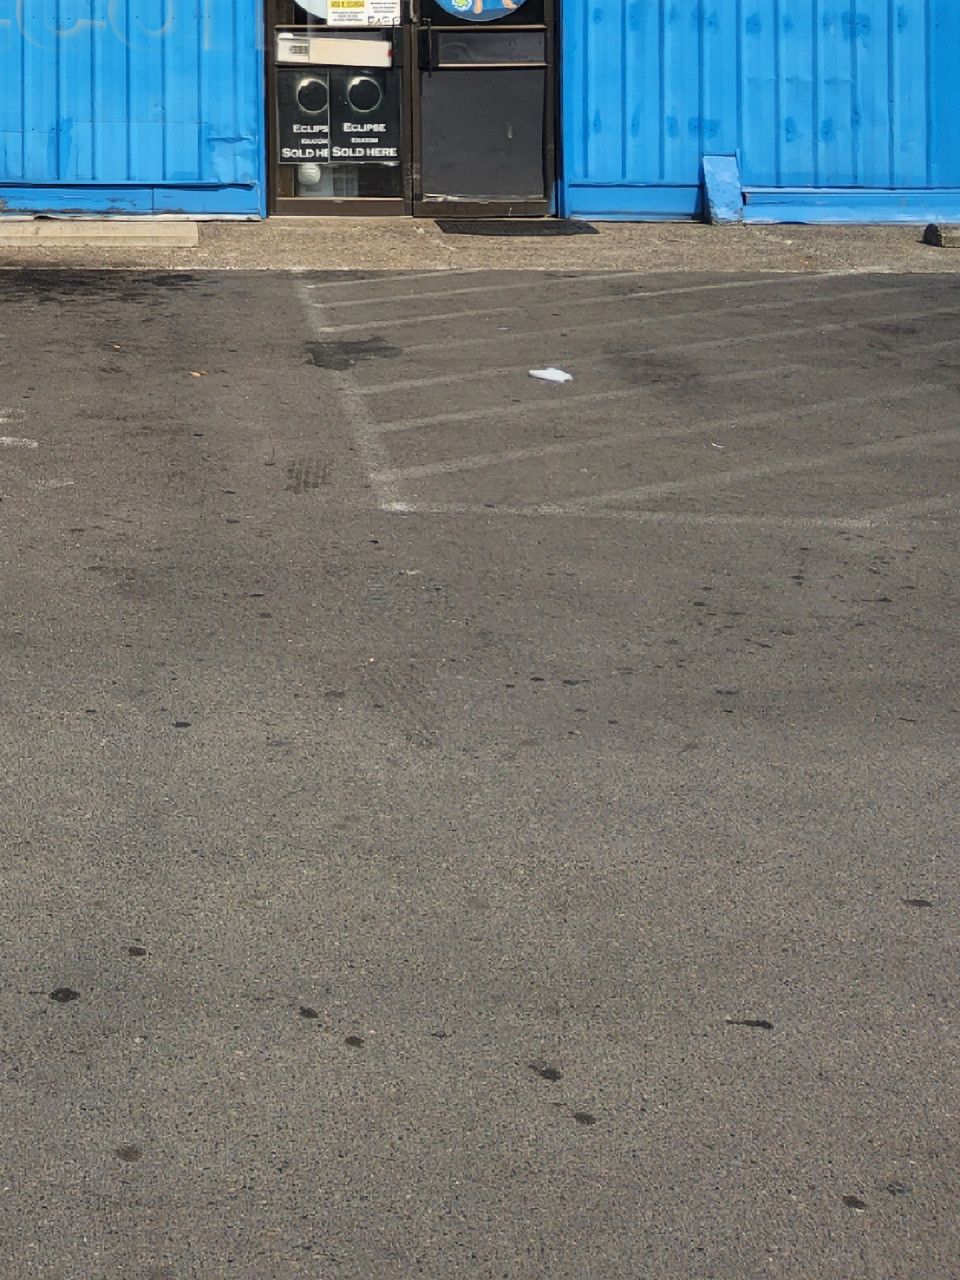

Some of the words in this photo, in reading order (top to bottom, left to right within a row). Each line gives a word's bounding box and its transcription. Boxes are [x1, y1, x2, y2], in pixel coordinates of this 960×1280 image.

[293, 124, 328, 133] ECLIPS
[343, 122, 386, 132] ECLIPSE
[282, 148, 315, 158] SOLD
[316, 149, 329, 158] HE
[332, 146, 365, 157] SOLD
[366, 147, 397, 157] HERE
